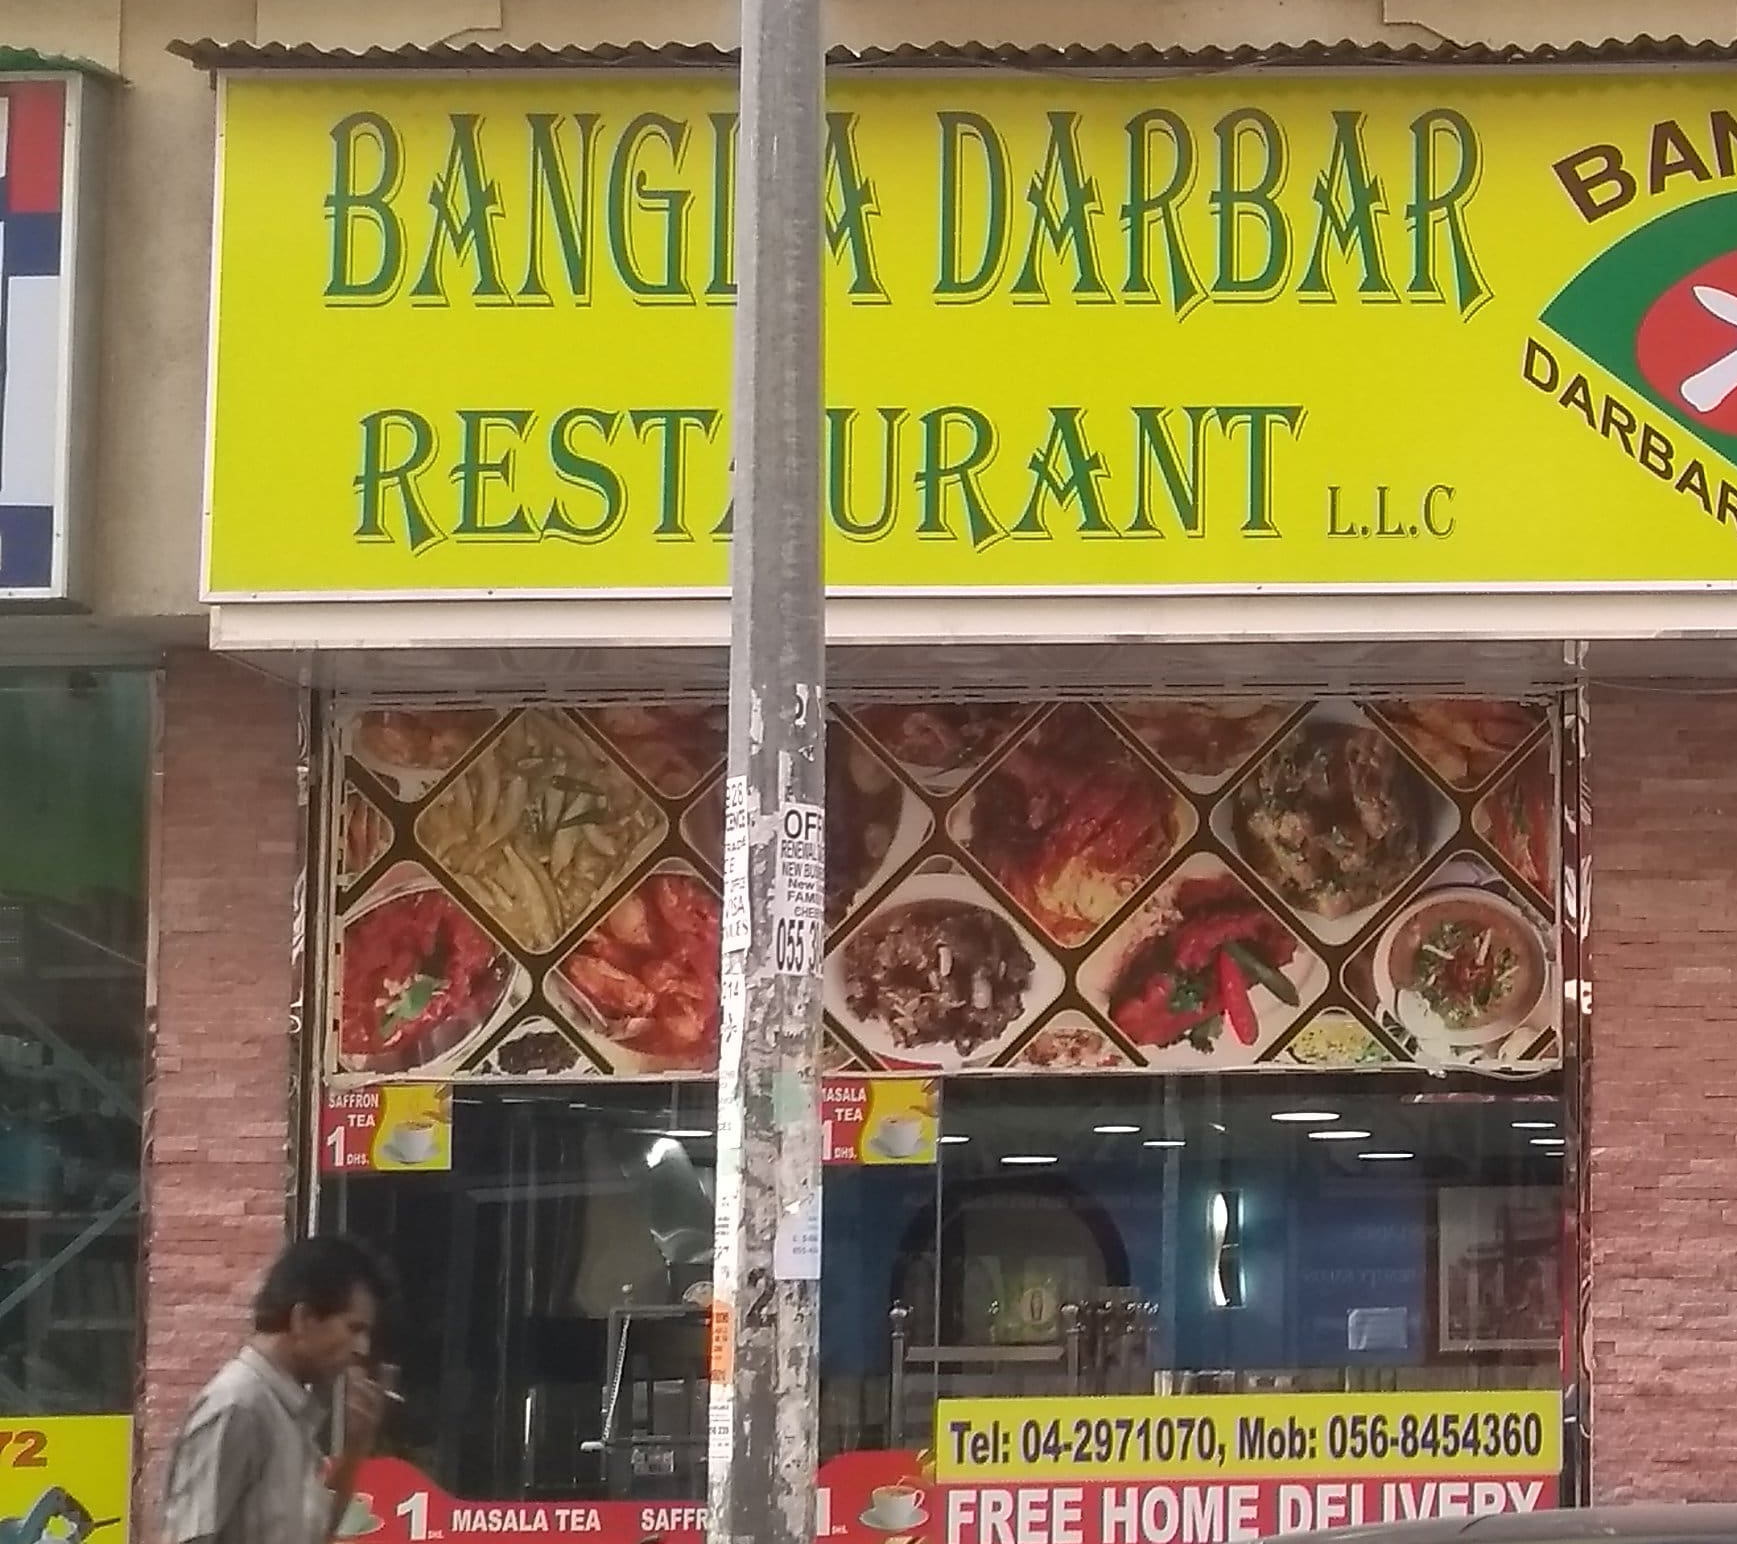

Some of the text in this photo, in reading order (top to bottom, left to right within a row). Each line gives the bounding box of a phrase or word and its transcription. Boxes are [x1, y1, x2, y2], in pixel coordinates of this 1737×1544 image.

[932, 108, 1494, 322] DARBAR
[353, 405, 1456, 556] RESTURANT L.L.C
[776, 918, 804, 971] 055
[328, 1093, 379, 1109] SAFFRON
[347, 1114, 376, 1127] TEA
[834, 1108, 864, 1121] TEA
[327, 1125, 345, 1167] 1
[950, 1411, 1543, 1469] Tel: 04-2971070, Mob: 056-8454360
[396, 1491, 429, 1542] 1
[451, 1508, 601, 1533] MASALA TEA
[641, 1508, 709, 1532] SAFFR
[1103, 1484, 1260, 1544] HOME
